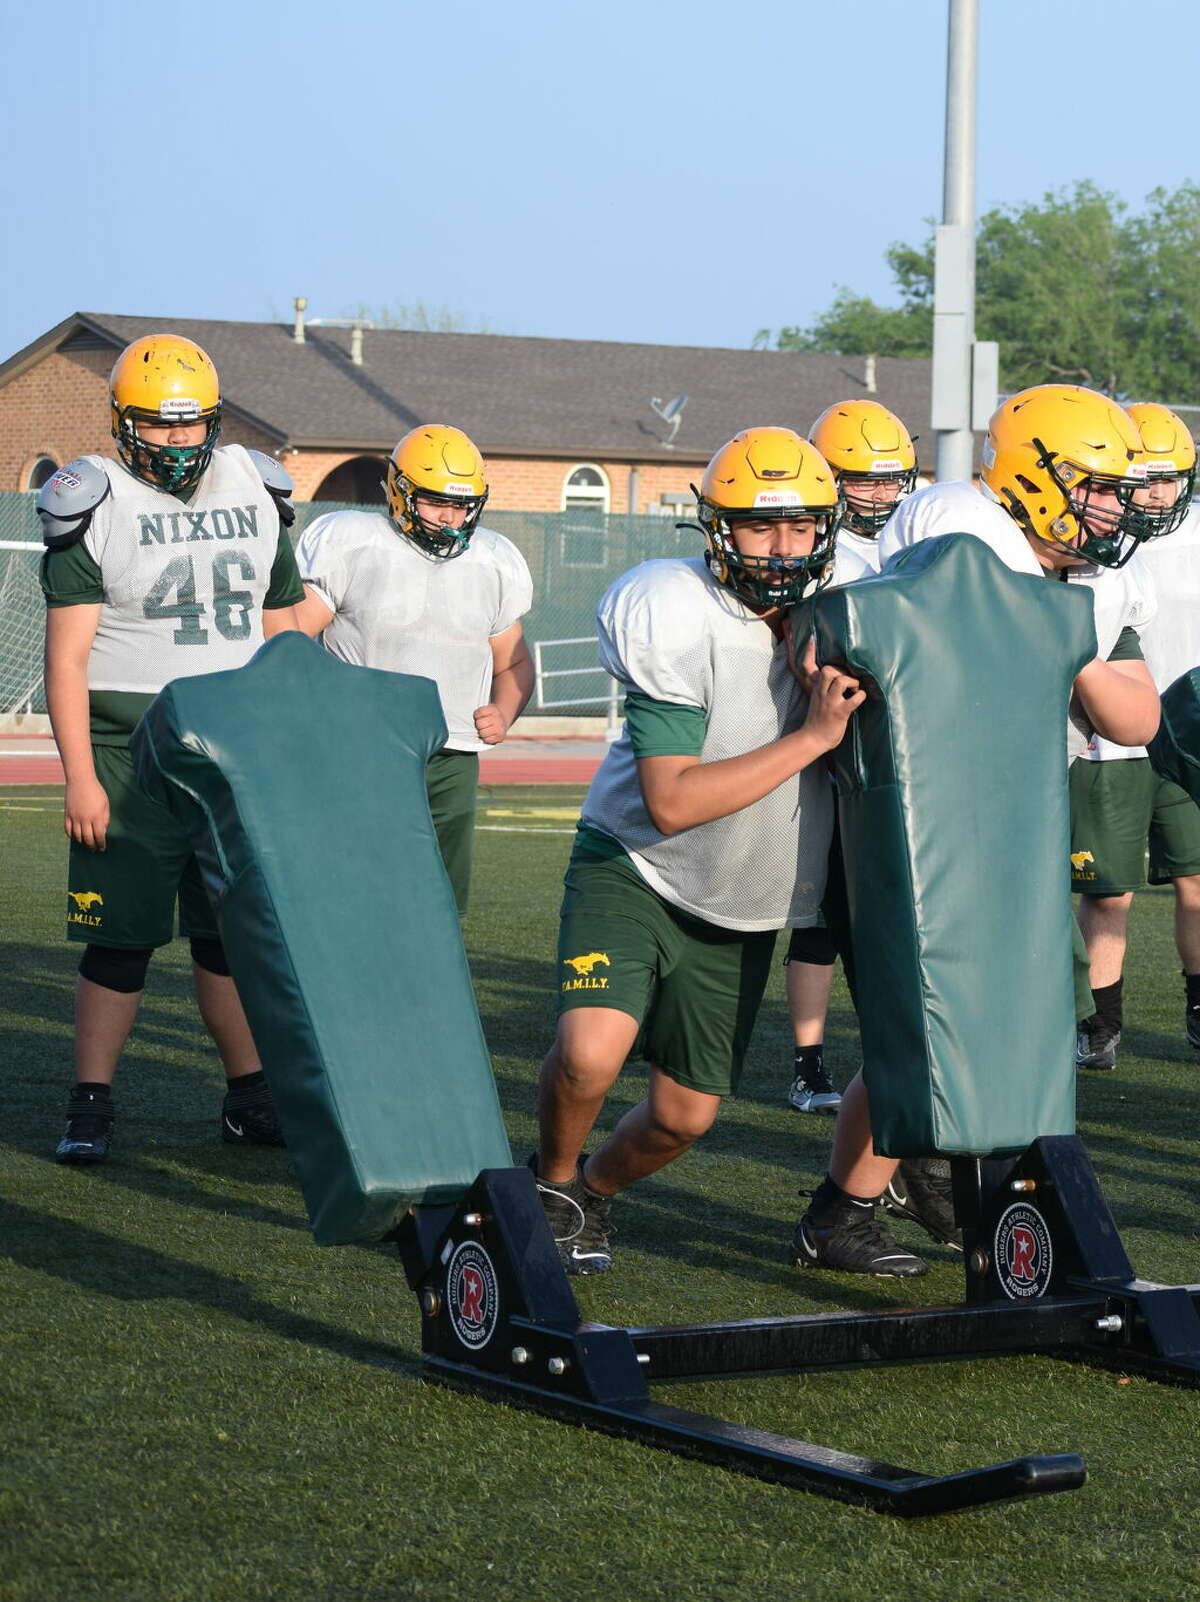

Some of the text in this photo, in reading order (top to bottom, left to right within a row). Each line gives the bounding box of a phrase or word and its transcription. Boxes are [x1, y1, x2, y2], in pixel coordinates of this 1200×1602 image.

[137, 505, 259, 546] NIXON
[142, 549, 256, 645] 46
[1011, 1226, 1037, 1281] R
[461, 1265, 484, 1324] R
[1006, 1276, 1039, 1297] ROGERS
